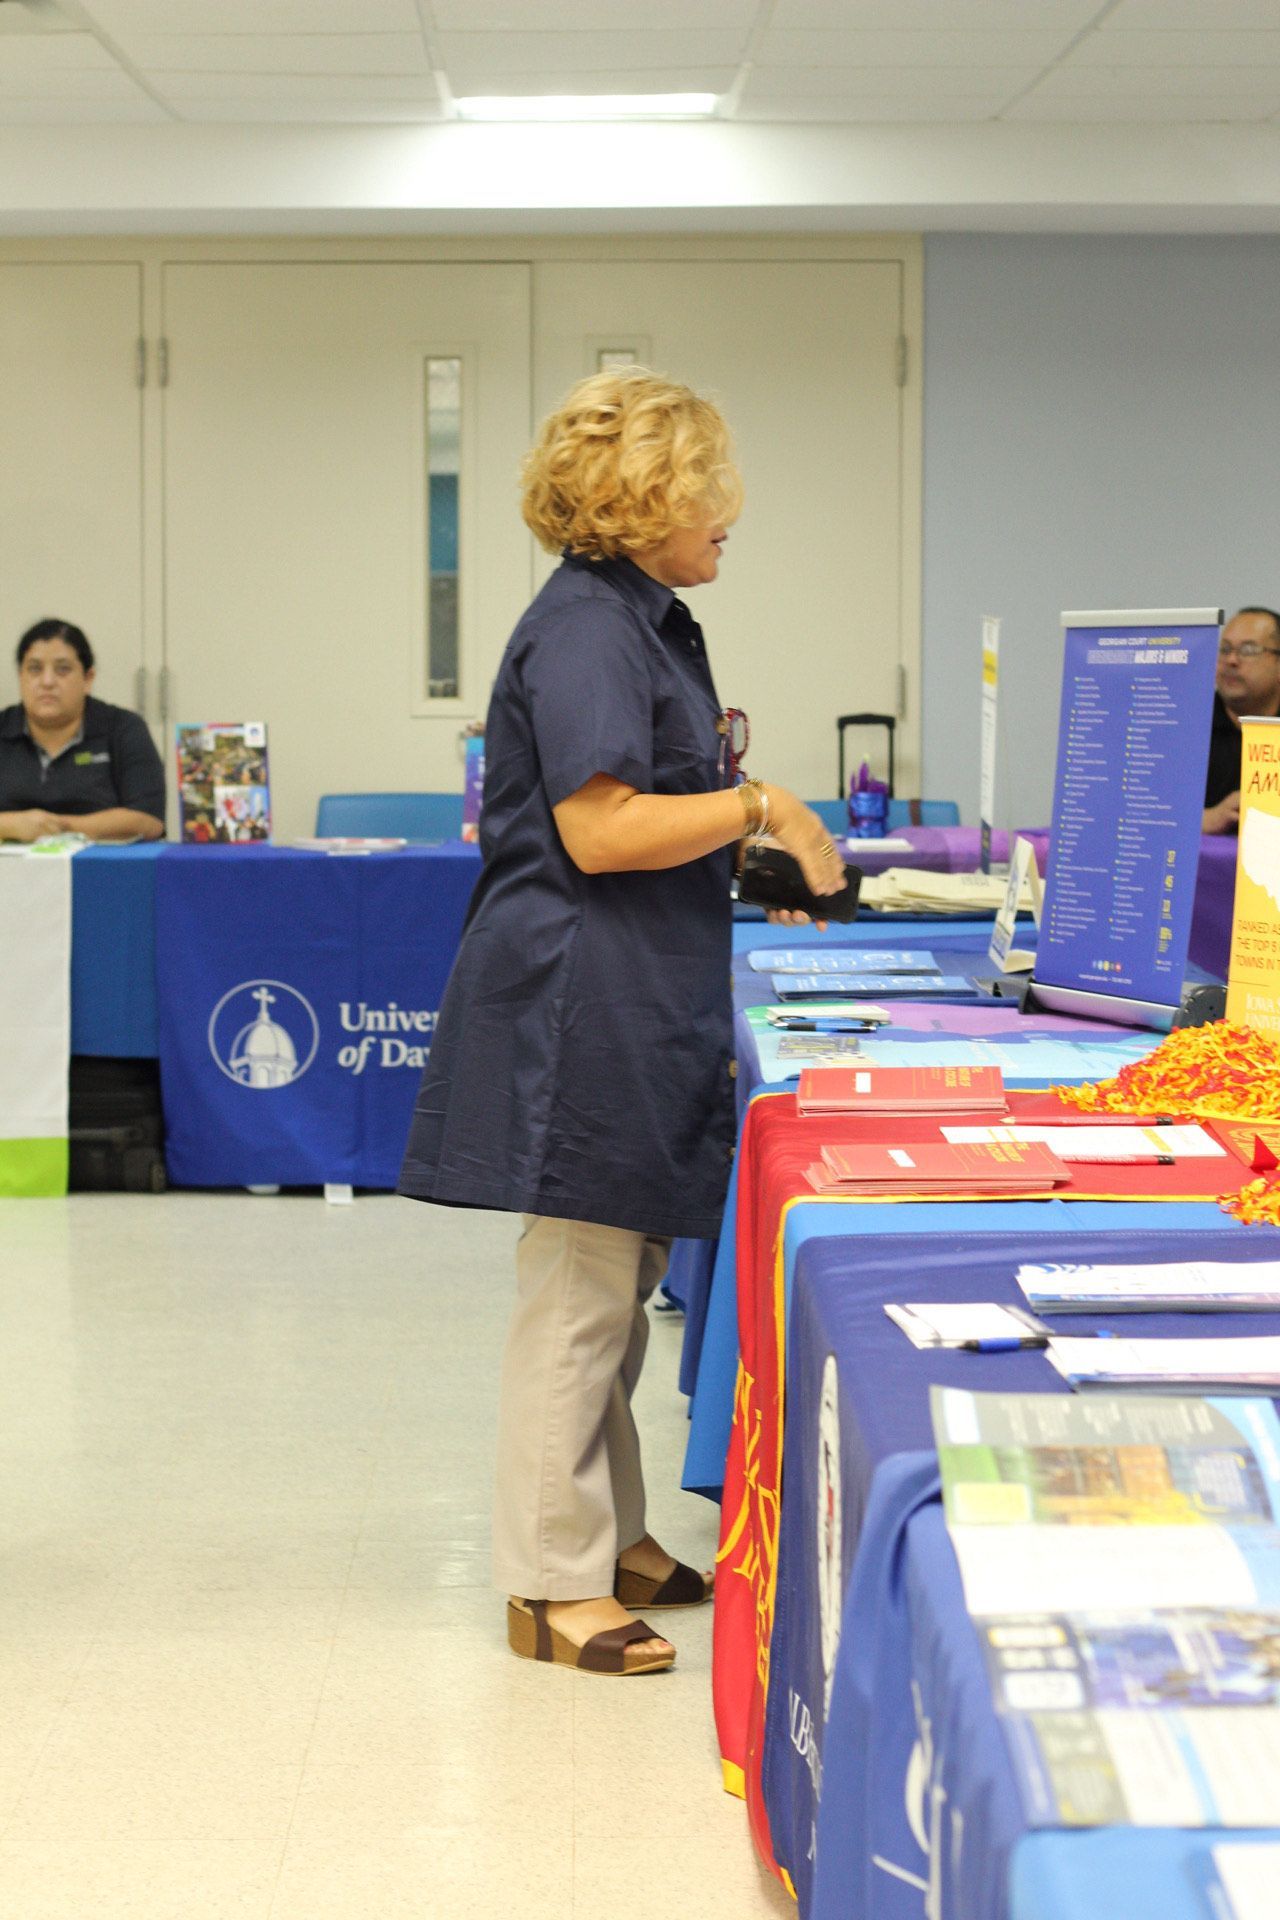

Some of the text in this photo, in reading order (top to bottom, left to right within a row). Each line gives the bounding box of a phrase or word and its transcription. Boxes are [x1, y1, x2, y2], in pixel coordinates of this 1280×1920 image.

[1248, 743, 1280, 763] WEL
[1247, 770, 1280, 796] AM
[337, 1036, 377, 1076] of
